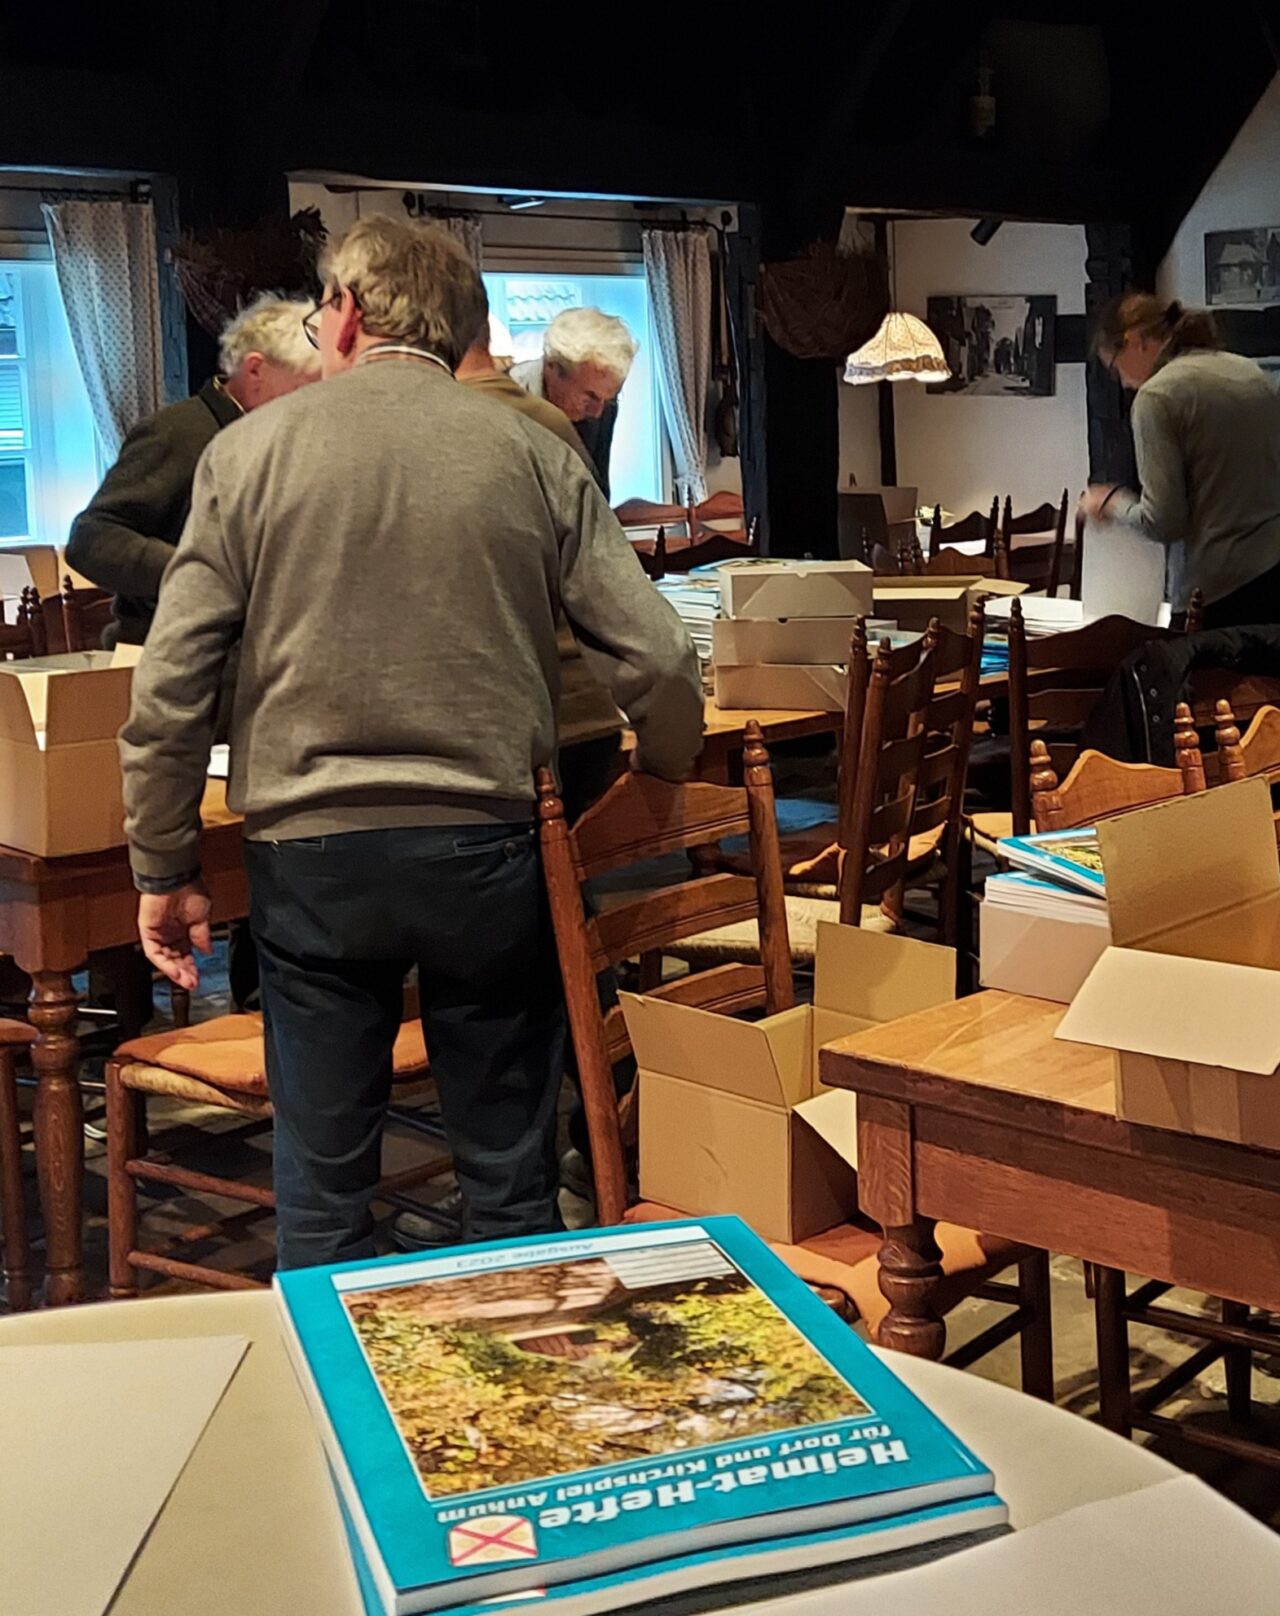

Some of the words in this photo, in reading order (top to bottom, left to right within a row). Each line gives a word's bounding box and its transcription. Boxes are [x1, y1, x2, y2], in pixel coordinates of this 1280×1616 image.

[456, 1253, 505, 1268] 2023
[512, 1242, 594, 1259] Ausgabe
[778, 1432, 842, 1456] Dorf
[848, 1424, 891, 1441] für
[716, 1445, 772, 1468] und
[539, 1440, 909, 1528] Heimat-Hefte
[557, 1460, 708, 1501] Kirchspiel
